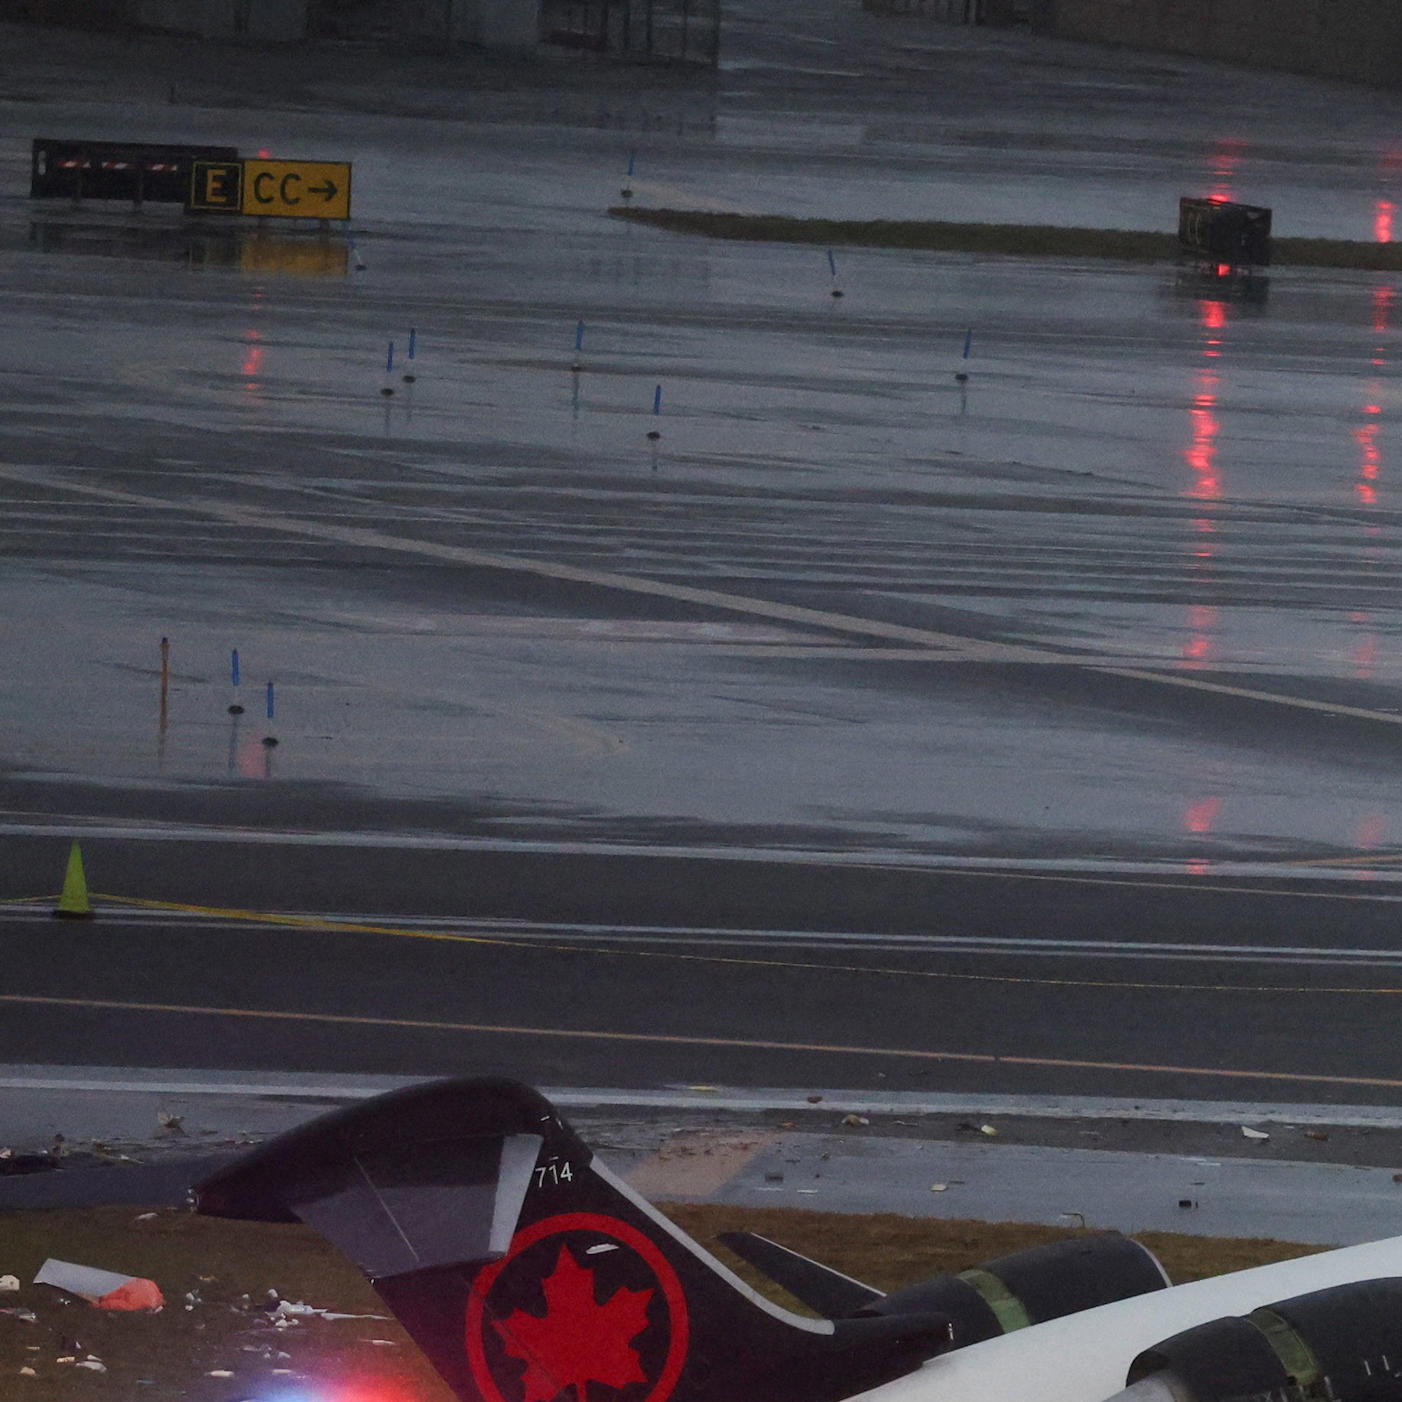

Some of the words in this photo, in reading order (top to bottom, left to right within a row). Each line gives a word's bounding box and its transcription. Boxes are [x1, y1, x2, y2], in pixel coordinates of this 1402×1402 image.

[206, 169, 227, 203] E
[253, 172, 302, 205] CC
[535, 1161, 573, 1188] 714
